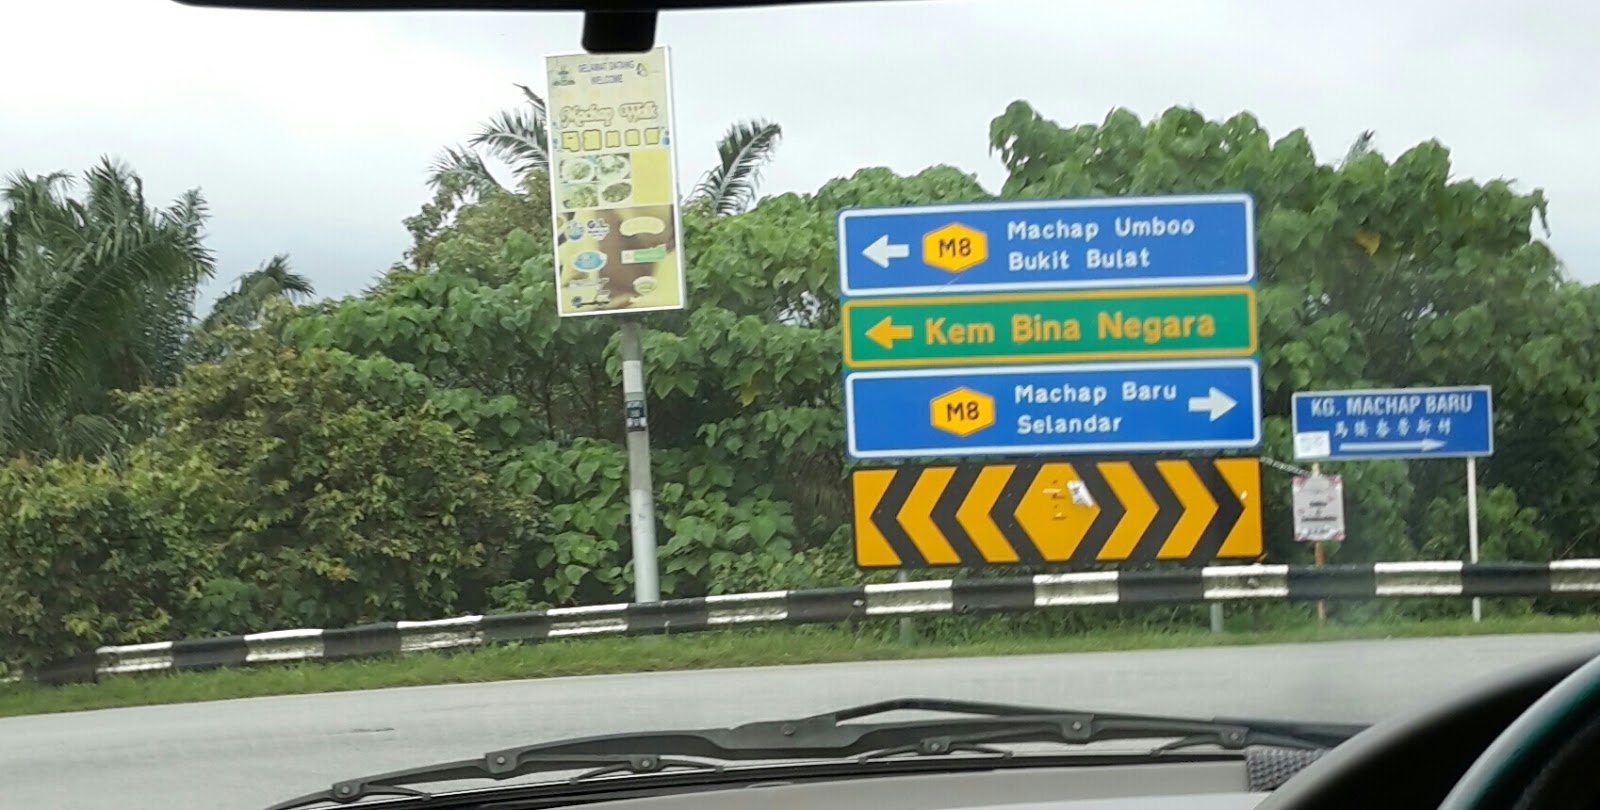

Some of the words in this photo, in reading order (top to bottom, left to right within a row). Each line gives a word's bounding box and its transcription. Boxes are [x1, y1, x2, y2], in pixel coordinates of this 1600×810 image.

[591, 74, 623, 85] WELCOME
[1007, 219, 1100, 242] Machap
[1115, 215, 1195, 237] Umboo
[938, 237, 972, 258] M8
[1008, 250, 1070, 271] Bukit
[1086, 247, 1151, 268] Bulat
[925, 317, 995, 345] Kem
[1011, 313, 1081, 342] Bina
[1098, 311, 1215, 343] Negara
[1015, 383, 1107, 406] Machap
[1122, 381, 1177, 400] Baru
[1346, 395, 1421, 416] MACHAP
[1425, 393, 1473, 413] BARU
[946, 404, 980, 422] M8
[1016, 415, 1122, 434] Selandar
